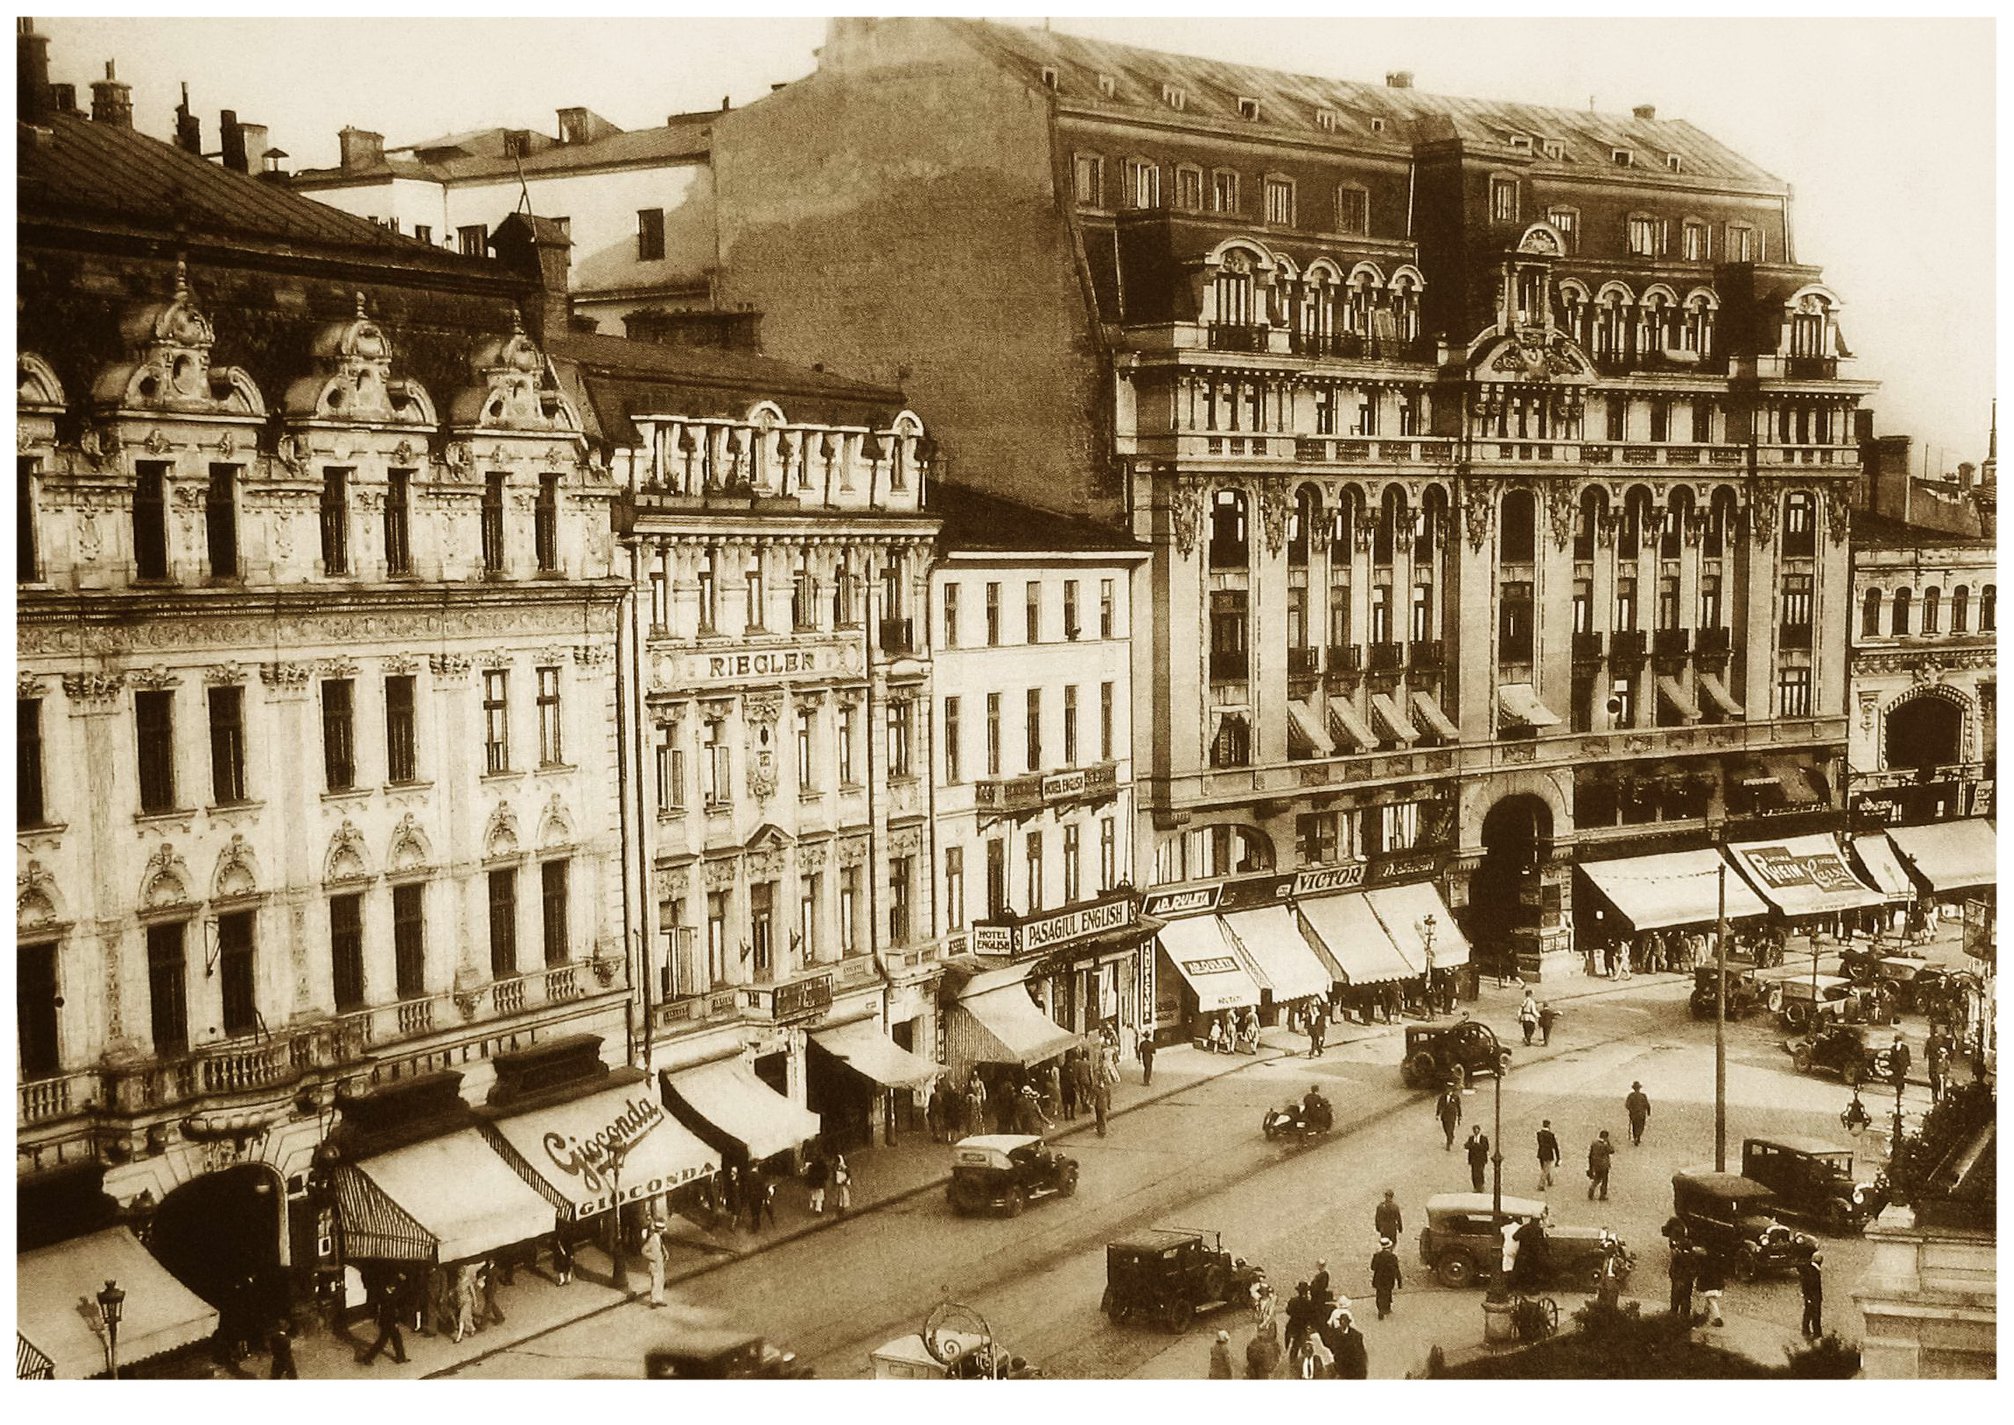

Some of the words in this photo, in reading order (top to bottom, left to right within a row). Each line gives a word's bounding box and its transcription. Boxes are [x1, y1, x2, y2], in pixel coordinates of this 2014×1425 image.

[709, 652, 815, 677] RIEGLER
[1300, 867, 1362, 891] VICTOR
[1747, 853, 1805, 884] RHEIN
[978, 930, 1007, 939] HOTEL
[1028, 914, 1078, 947] PASAGIUL
[1081, 903, 1123, 932] ENGLISH
[976, 939, 1010, 952] ENGLISH
[543, 1098, 664, 1193] Gioconda
[579, 1162, 716, 1216] GIOCONDA
